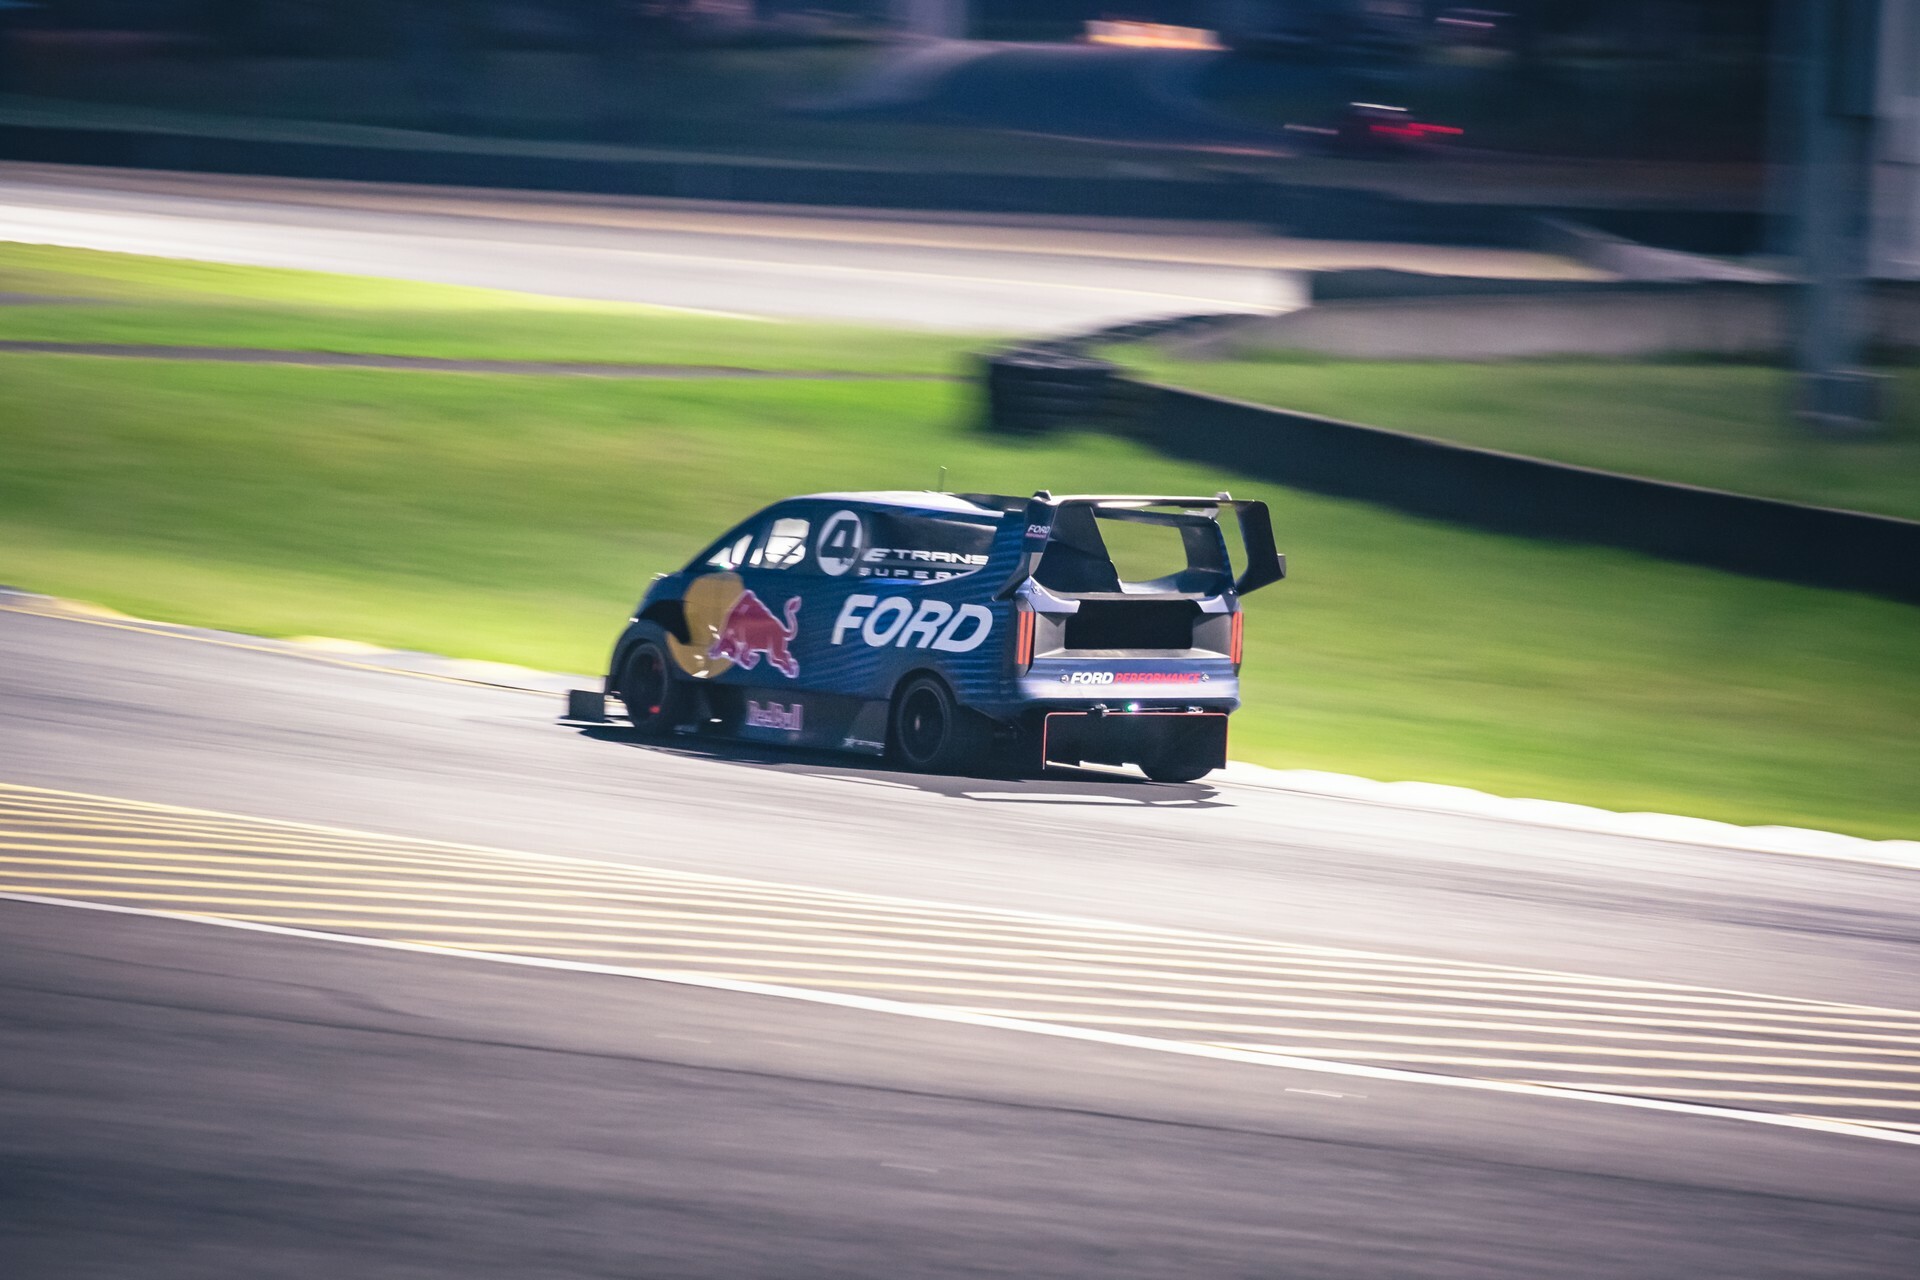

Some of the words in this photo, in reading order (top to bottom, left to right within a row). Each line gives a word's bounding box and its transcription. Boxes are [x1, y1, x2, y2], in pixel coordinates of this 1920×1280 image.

[831, 594, 994, 653] FORD
[1070, 672, 1114, 684] FORD
[1114, 672, 1201, 684] PERFORMANCE
